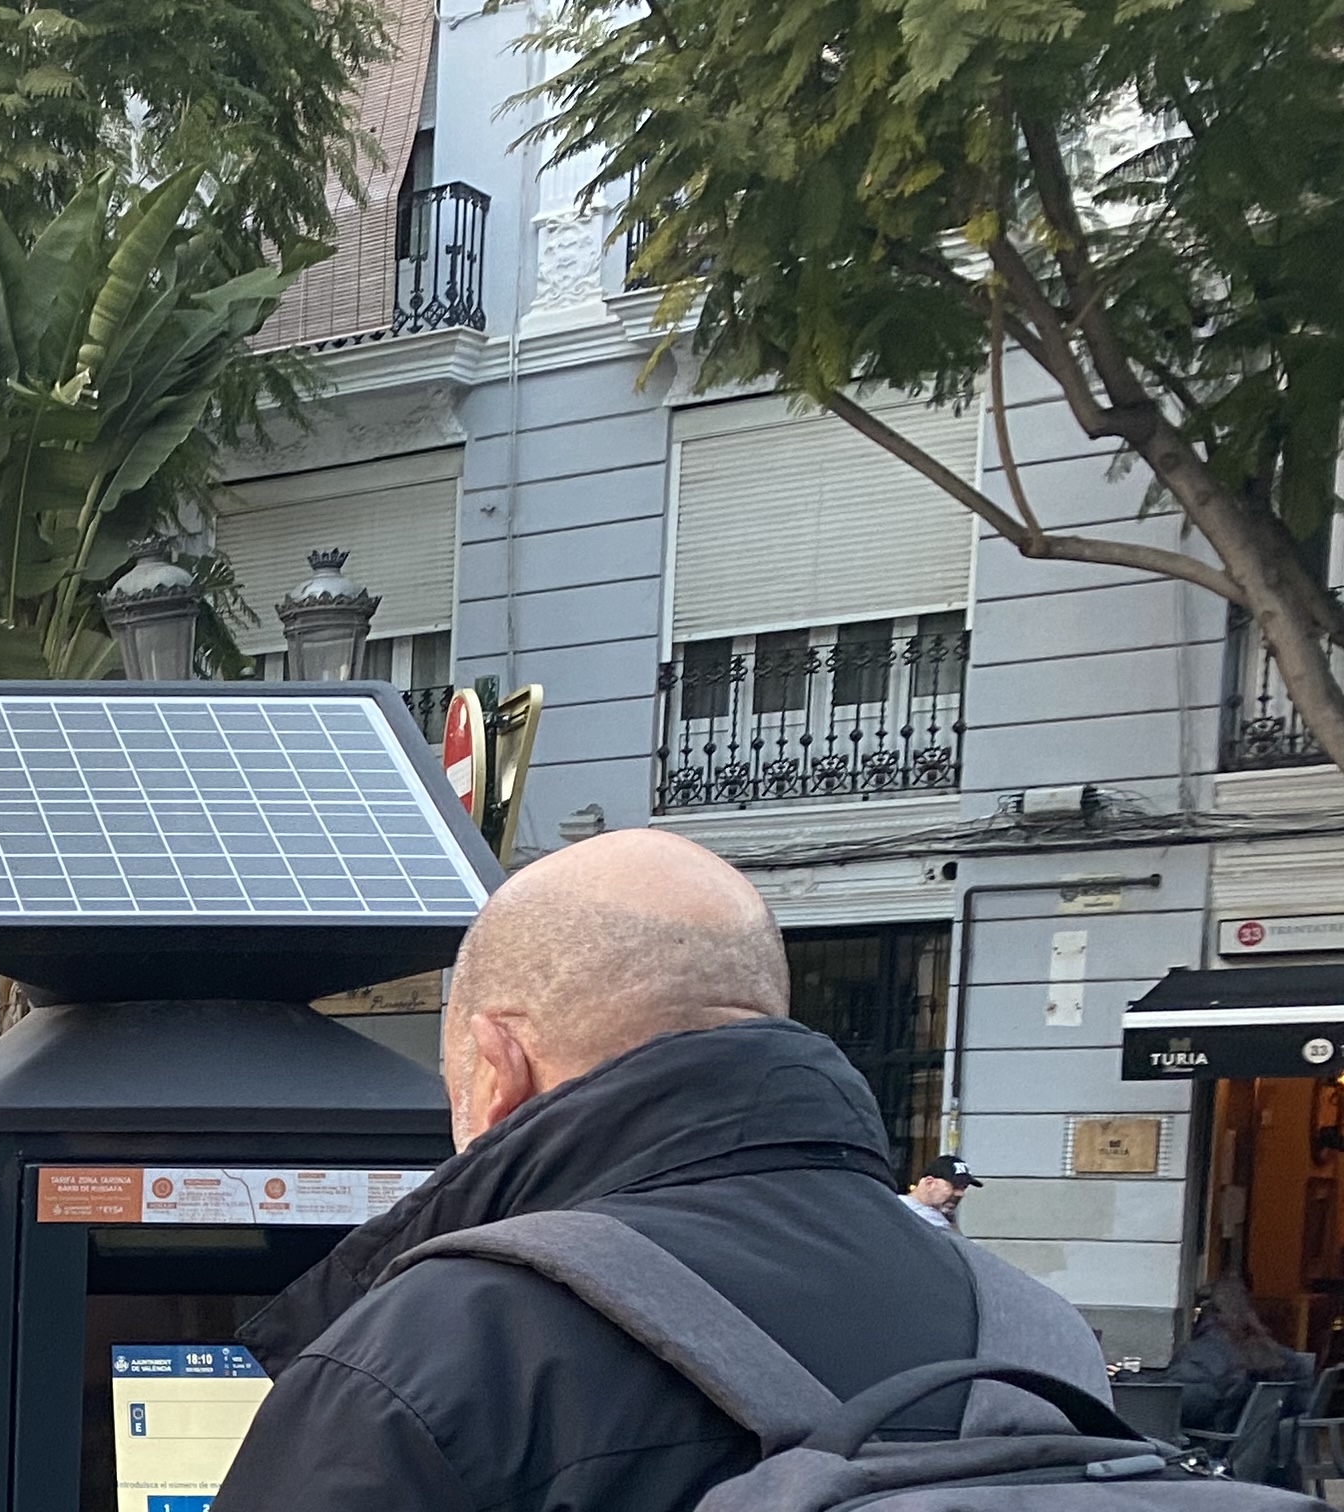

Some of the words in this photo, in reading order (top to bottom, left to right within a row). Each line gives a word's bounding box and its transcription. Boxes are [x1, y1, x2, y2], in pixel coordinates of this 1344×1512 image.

[1149, 1053, 1210, 1066] TURIA
[185, 1353, 213, 1365] 18:10
[135, 1422, 142, 1433] E
